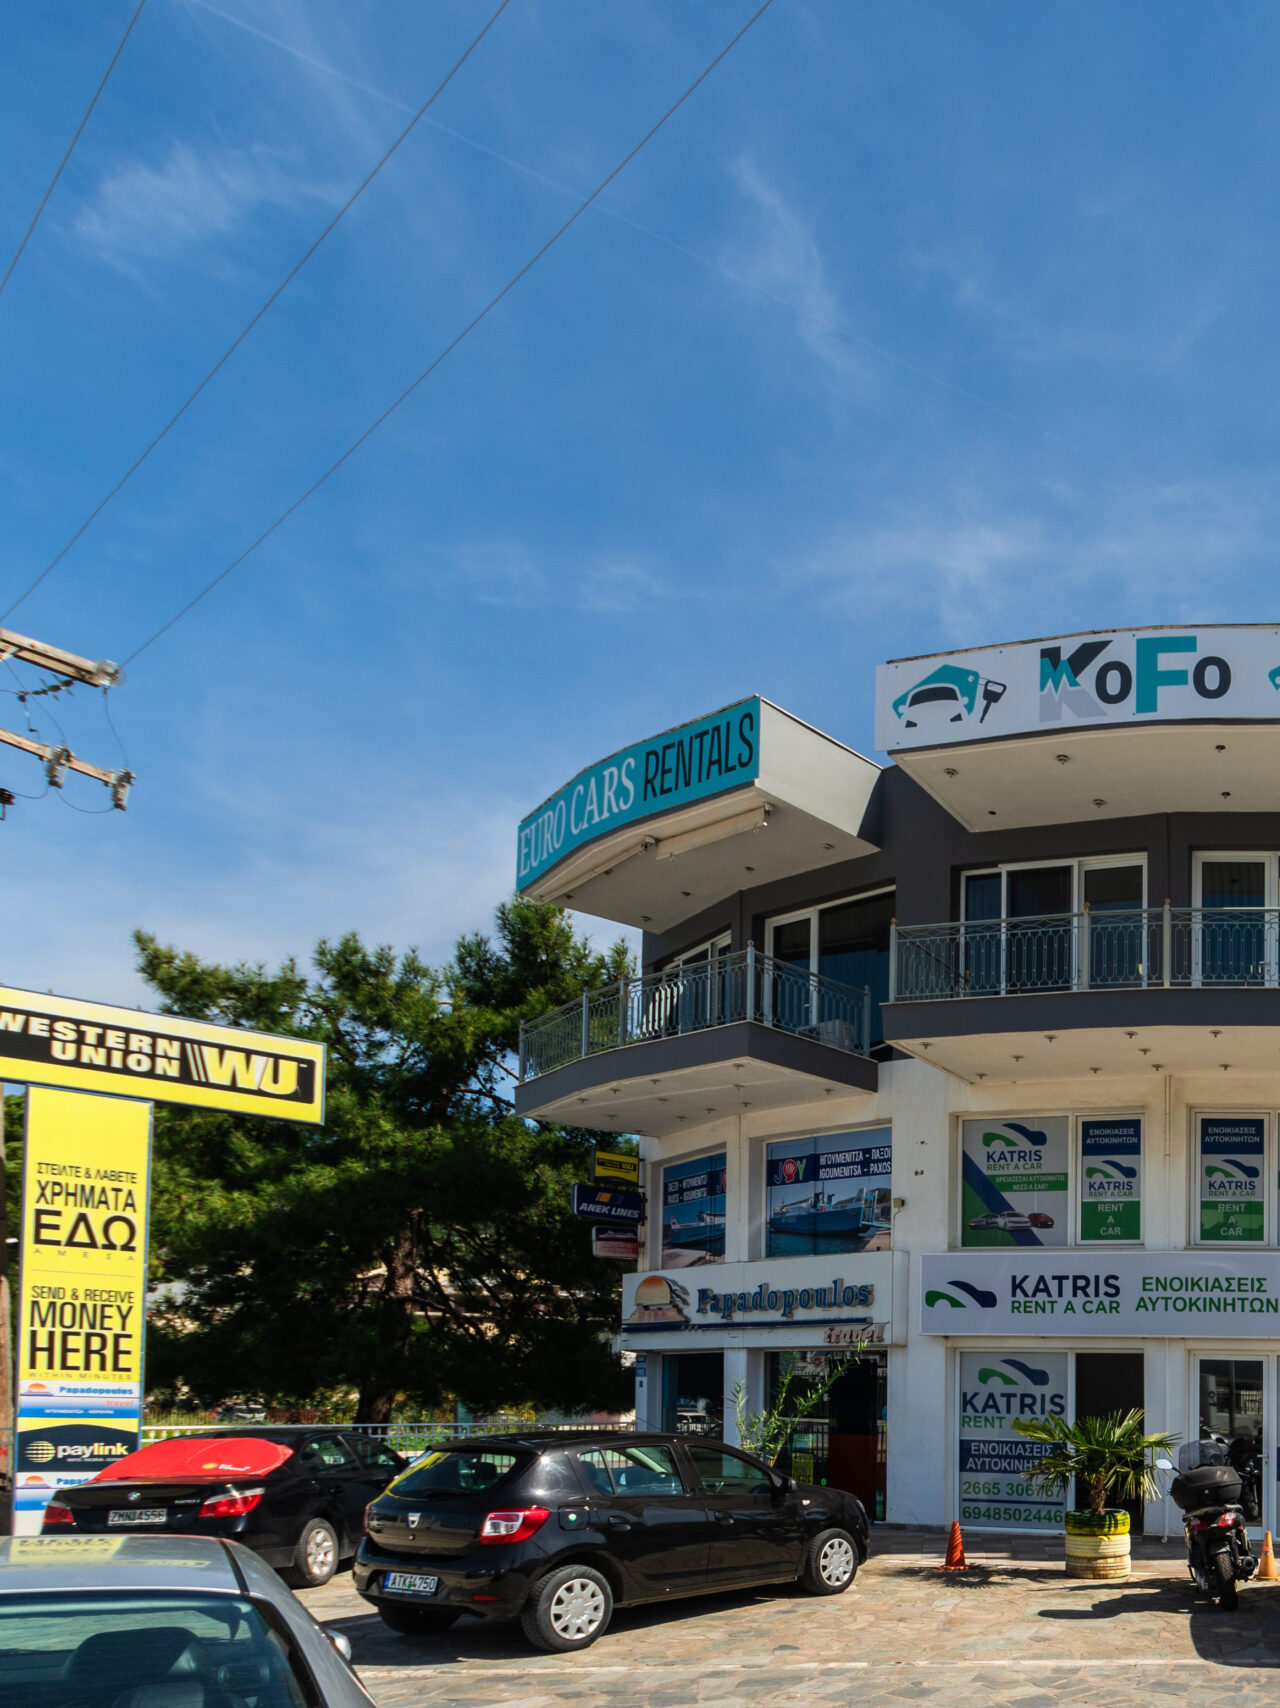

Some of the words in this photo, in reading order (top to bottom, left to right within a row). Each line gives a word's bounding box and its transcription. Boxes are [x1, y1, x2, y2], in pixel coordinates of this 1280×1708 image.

[518, 811, 566, 878] EURO
[570, 757, 636, 836] CARS
[643, 711, 755, 802] RENTALS
[0, 1011, 181, 1060] WESTERN
[201, 1045, 299, 1096] WU
[51, 1040, 181, 1078] UNION
[1089, 1128, 1135, 1136] ΕΝΟΙΚΙΑΣΕΙΣ
[1208, 1126, 1257, 1134] ΕΝΟΙΚΙΑΣΕΙΣ
[1086, 1136, 1138, 1145] ΑΥΤΟΚΙΝΗΤΩΝ
[1204, 1135, 1260, 1143] ΑΥΤΟΚΙΝΗΤΩΝ
[820, 1150, 864, 1166] ΗΓΟΥΜΕΝΙΤΣΑ
[986, 1149, 1042, 1163] KATRIS
[37, 1162, 82, 1178] ΣΤΕΙΛΤΕ
[84, 1167, 92, 1179] &
[94, 1168, 137, 1184] ΛΑΒΕΤΕ
[820, 1165, 862, 1179] IGOUMENITSA
[869, 1161, 891, 1175] PAXOS
[987, 1163, 1010, 1171] RENT
[1013, 1163, 1021, 1171] A
[1023, 1162, 1042, 1170] CAR
[1088, 1181, 1133, 1191] KATRIS
[1208, 1180, 1256, 1190] KATRIS
[35, 1179, 137, 1213] ΧΡΗΜΑΤΑ
[579, 1202, 609, 1215] ANEK
[611, 1206, 641, 1218] LINES
[1098, 1203, 1124, 1212] RENT
[1218, 1203, 1246, 1212] RENT
[1107, 1215, 1115, 1224] A
[1228, 1215, 1236, 1224] A
[33, 1208, 136, 1252] ΕΔΩ
[1100, 1227, 1121, 1236] CAR
[1220, 1227, 1243, 1236] CAR
[1011, 1274, 1121, 1298] KATRIS
[1142, 1276, 1268, 1294] ΕΝΟΙΚΙΑΣΕΙΣ
[31, 1285, 66, 1300] SEND
[71, 1288, 79, 1301] &
[84, 1288, 135, 1304] RECEIVE
[696, 1278, 873, 1320] Papadopoulos
[1011, 1300, 1057, 1314] RENT
[1064, 1300, 1077, 1314] A
[1082, 1300, 1121, 1314] CAR
[1135, 1296, 1279, 1314] ΑΥΤΟΚΙΝΗΤΩΝ
[30, 1300, 134, 1331] MONEY
[823, 1323, 885, 1344] travel
[29, 1329, 133, 1373] HERE
[59, 1386, 134, 1396] Papadopoulos
[962, 1391, 1066, 1416] KATRIS
[962, 1415, 1006, 1429] RENT
[57, 1442, 129, 1459] paylink
[971, 1442, 1054, 1457] ΕΝΟΙΚΙΑΣΕΙΣ
[966, 1457, 1040, 1472] ΑΥΤΟΚΙΝΗ
[963, 1481, 1001, 1496] 2665
[962, 1506, 1064, 1523] 6948502446
